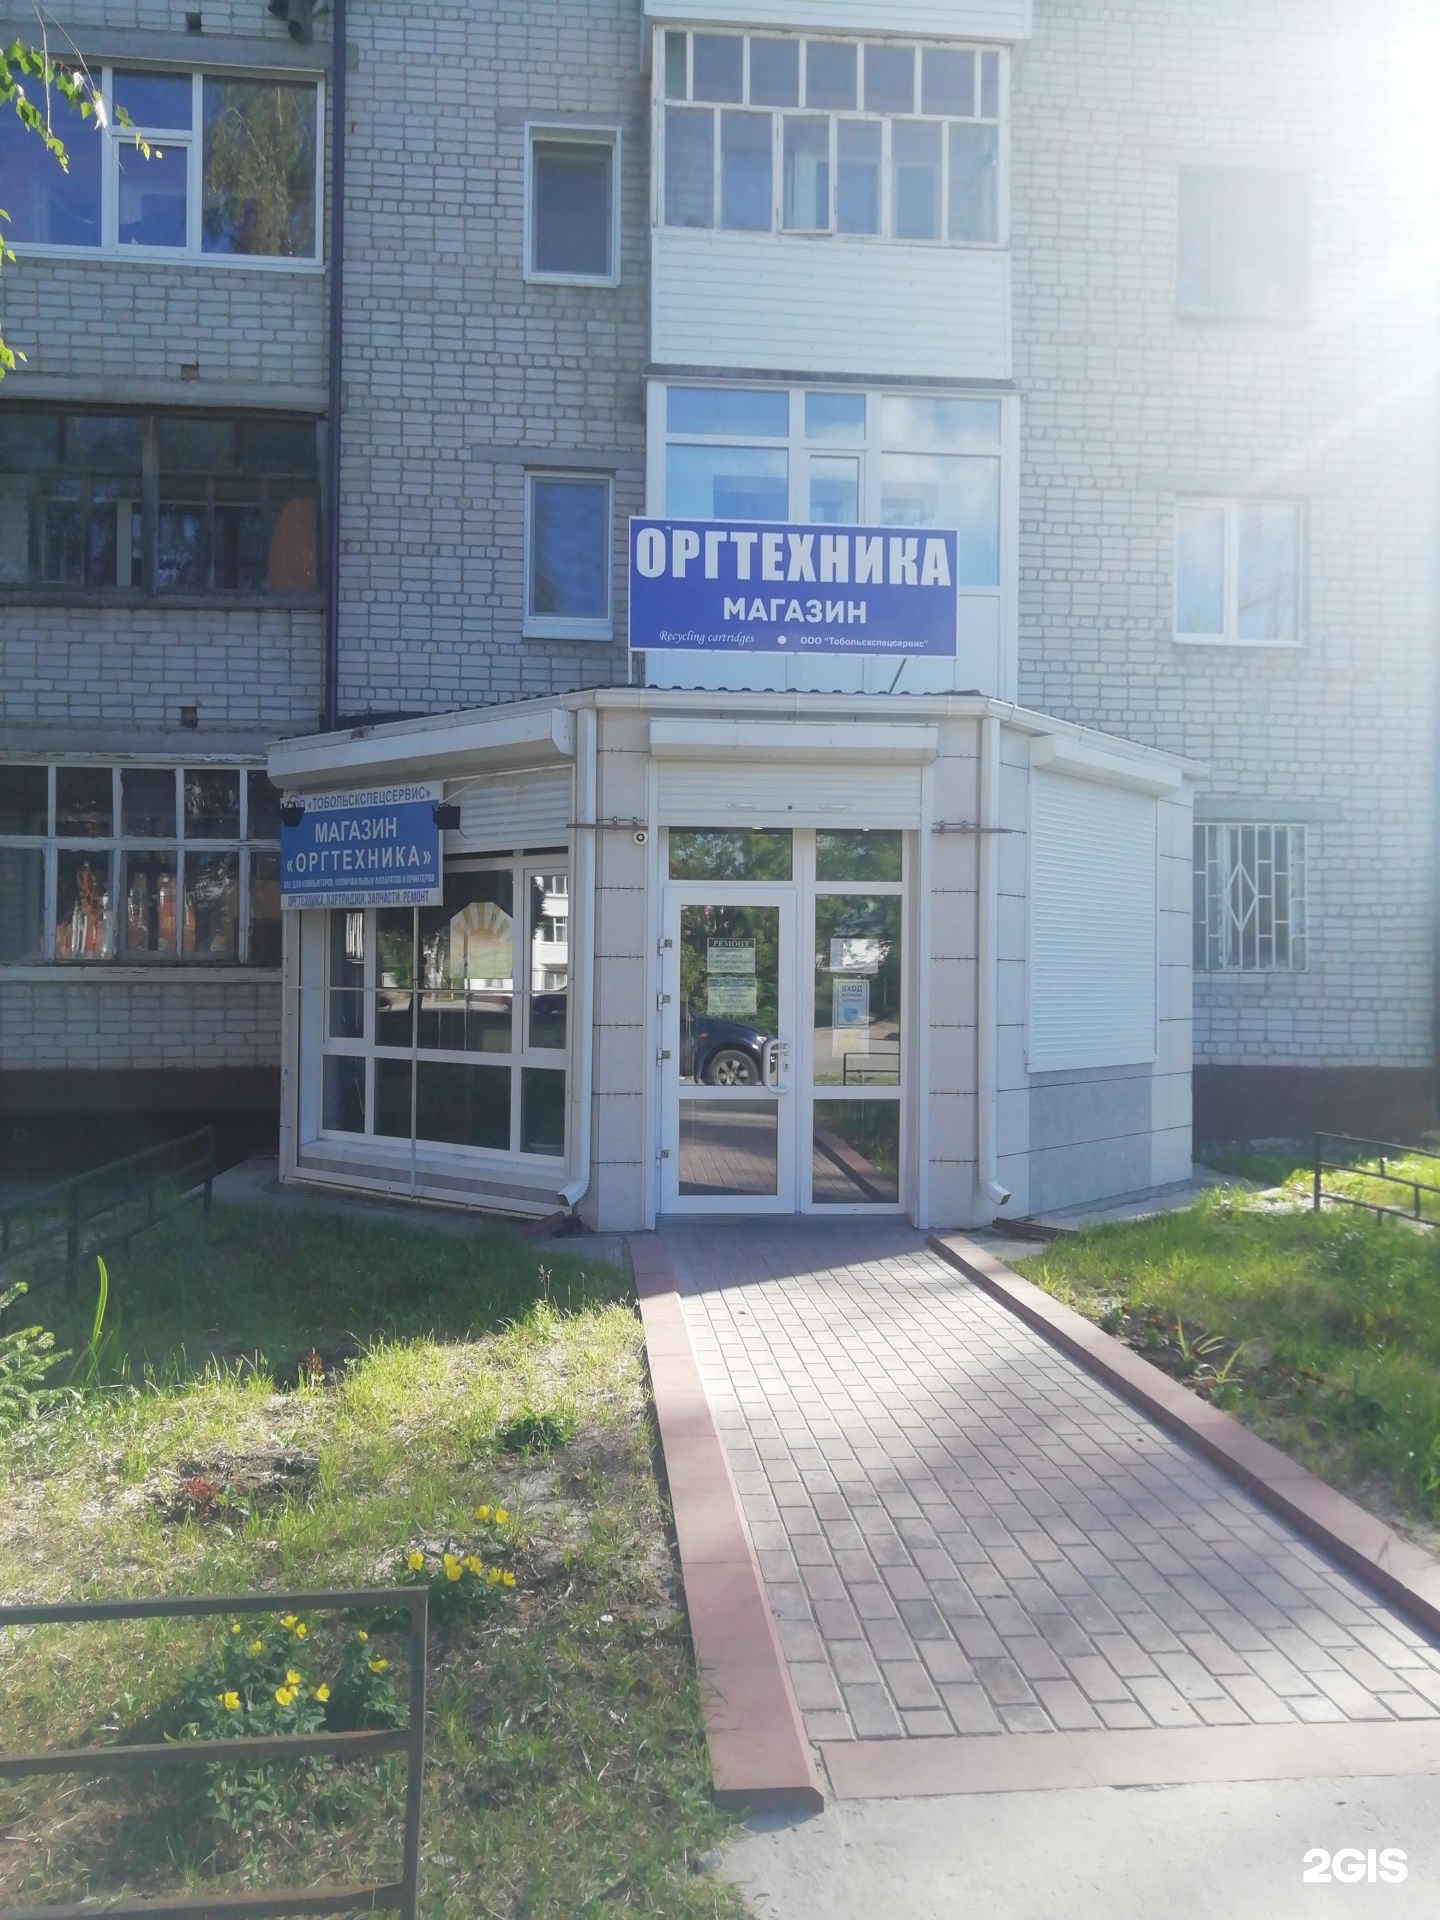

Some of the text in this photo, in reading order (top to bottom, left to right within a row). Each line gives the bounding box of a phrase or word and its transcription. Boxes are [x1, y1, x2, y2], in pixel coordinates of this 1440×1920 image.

[636, 527, 951, 587] ОРГТЕХНИКА
[723, 597, 867, 624] МАГАЗИН
[659, 630, 755, 645] Recycling cartridges
[800, 636, 822, 645] ООО
[308, 787, 431, 810] «ТОБОЛЬСКСПЕЦСЕРВИС»
[315, 817, 397, 843] МАГАЗИН
[286, 845, 432, 873] «ОРГТЕХНИКА»
[407, 873, 435, 883] ПРИНТЕРОВ
[327, 892, 366, 906] КАРТРИДЖИ,
[368, 891, 402, 905] ЗАПЧАСТИ,
[403, 891, 429, 904] РЕМОНТ
[841, 985, 863, 993] ВХОД
